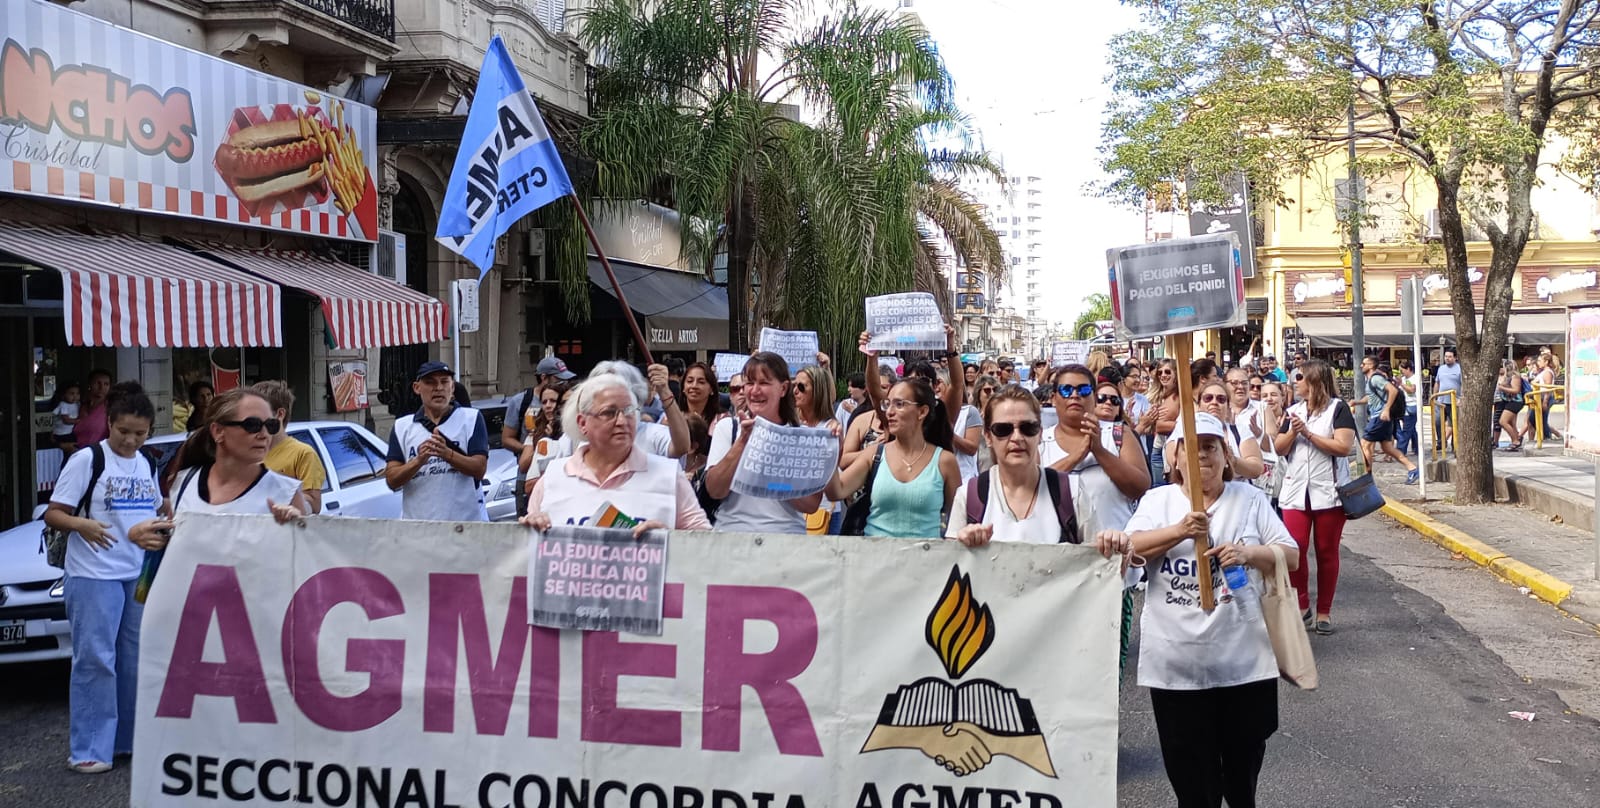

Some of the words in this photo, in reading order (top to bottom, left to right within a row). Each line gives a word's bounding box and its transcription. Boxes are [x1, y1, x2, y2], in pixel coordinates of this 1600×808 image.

[0, 39, 197, 163] NCHOS
[1, 120, 104, 170] Cristóbal
[1139, 265, 1200, 284] ¡EXIGIMOS
[1201, 263, 1216, 275] EL
[1129, 285, 1163, 300] PAGO
[1165, 283, 1189, 296] DEL
[1189, 278, 1226, 293] FONID!
[871, 307, 888, 316] LOS
[874, 315, 925, 325] ESCOLARES
[925, 314, 939, 324] DE
[651, 327, 674, 343] STELLA
[677, 328, 698, 343] ARTOIS
[874, 325, 891, 334] LAS
[763, 441, 833, 458] COMEDORES
[798, 435, 828, 447] PARA
[748, 448, 809, 468] ESCOLARES
[810, 459, 825, 469] DE
[743, 460, 761, 474] LAS
[763, 466, 825, 480] ESCUELAS!
[538, 540, 562, 560] ¡LA
[565, 542, 662, 565] EDUCACIÓN
[548, 558, 619, 581] PÚBLICA
[622, 565, 648, 582] NO
[544, 578, 565, 596] SE
[568, 580, 649, 603] NEGOCIA!
[3, 626, 23, 641] 974
[154, 563, 824, 758] AGMER
[160, 752, 461, 808] SECCIONAL
